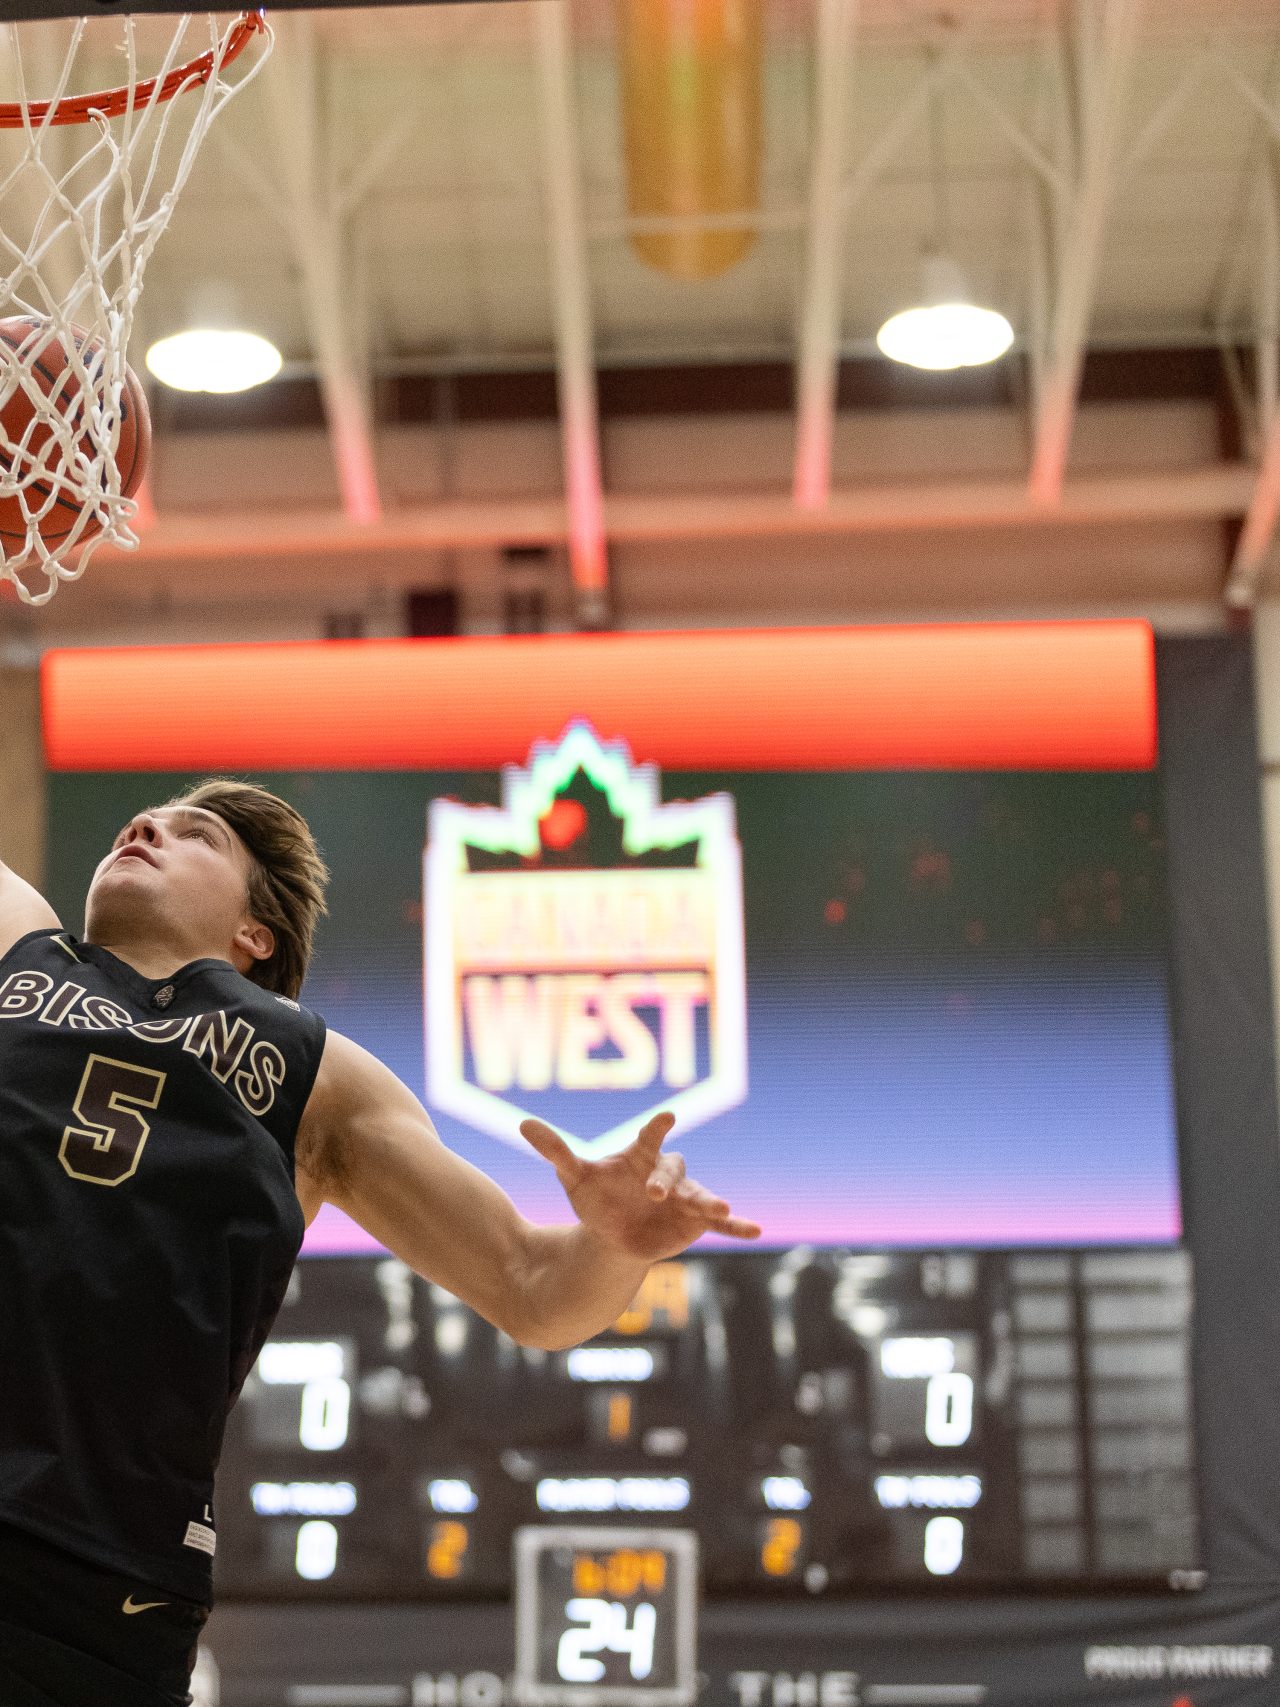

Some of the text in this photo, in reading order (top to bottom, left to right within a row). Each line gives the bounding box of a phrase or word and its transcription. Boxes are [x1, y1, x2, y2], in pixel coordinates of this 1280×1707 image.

[463, 974, 708, 1091] WEST
[58, 1053, 167, 1187] 5
[558, 1598, 657, 1682] 24
[1084, 1644, 1273, 1680] PROUD PARTNER
[727, 1670, 860, 1707] THE
